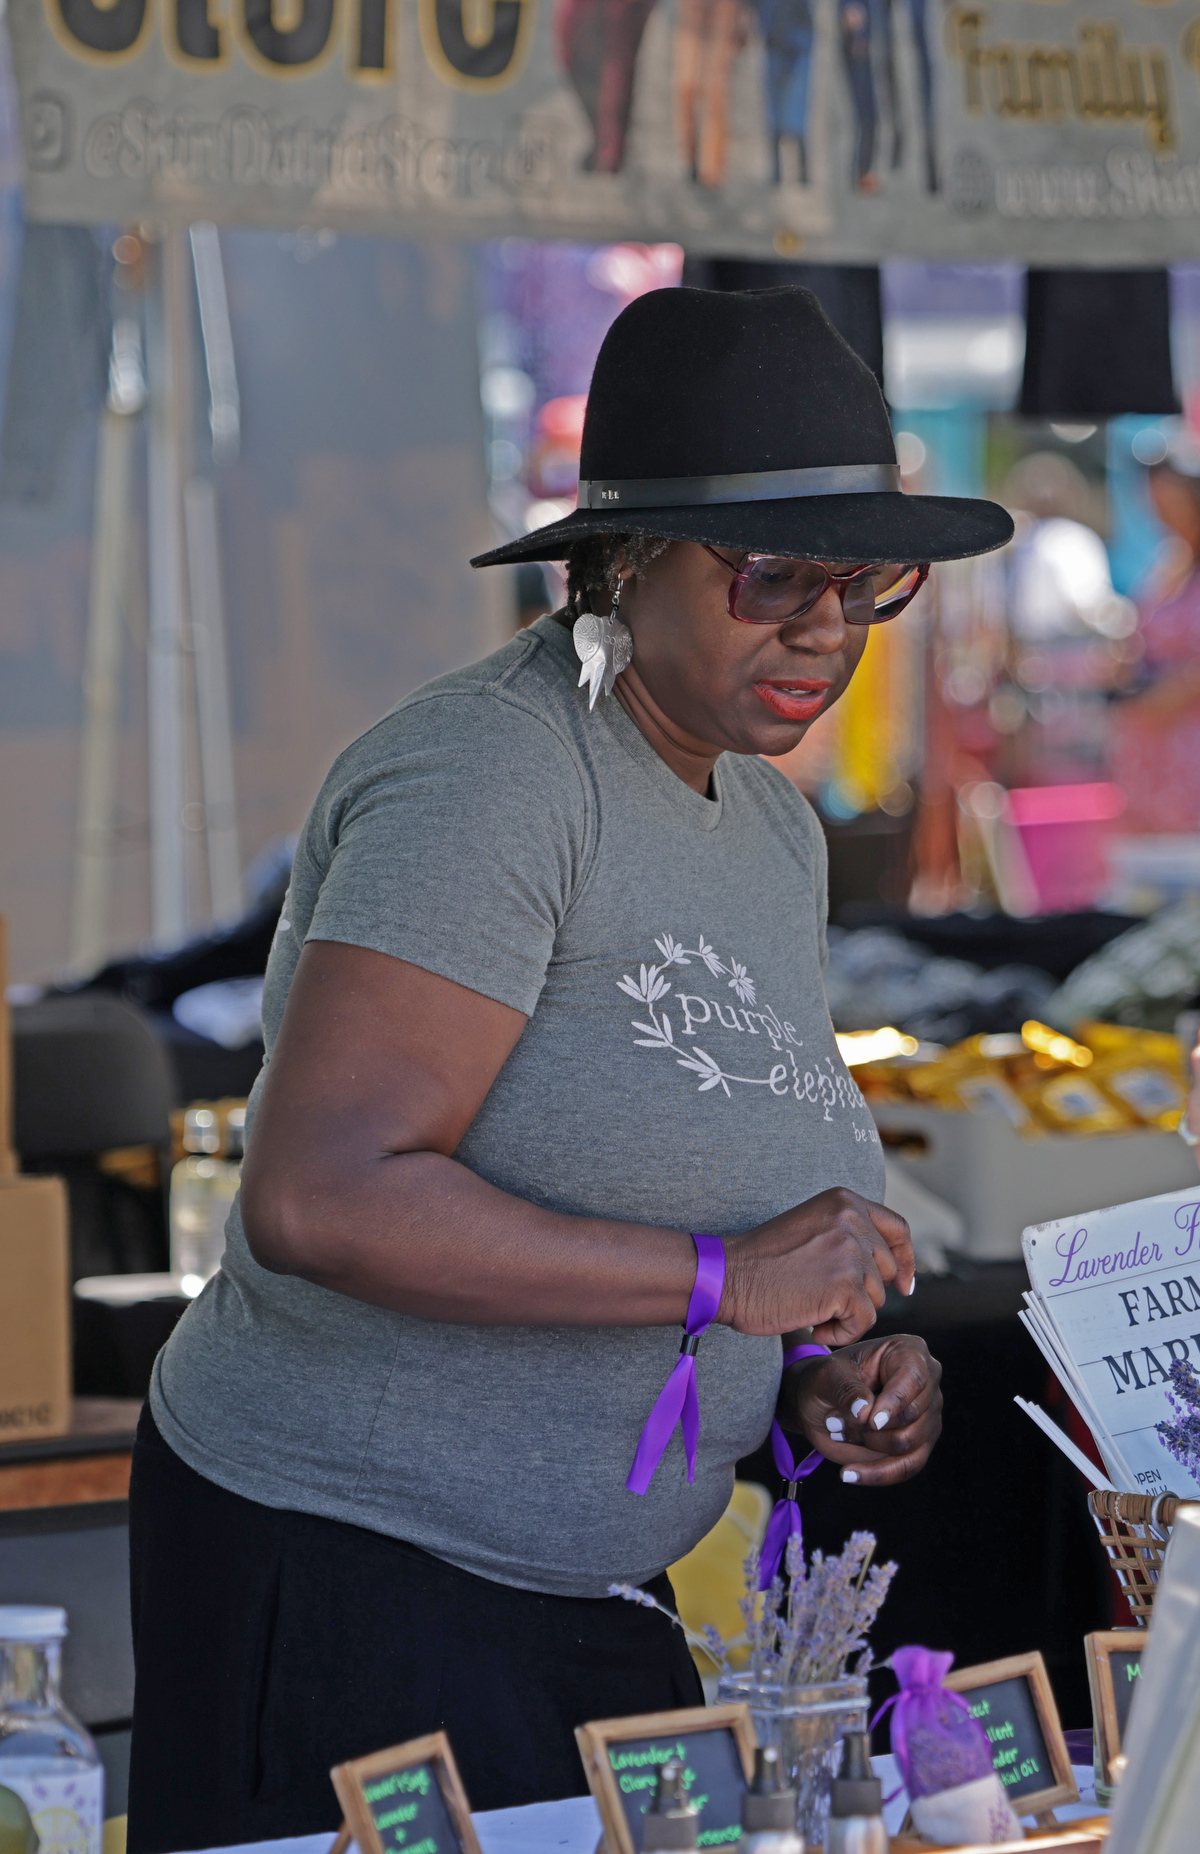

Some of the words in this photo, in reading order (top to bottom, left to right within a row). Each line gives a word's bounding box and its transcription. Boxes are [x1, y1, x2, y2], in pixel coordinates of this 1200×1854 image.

[674, 993, 803, 1051] purple
[1049, 1228, 1163, 1287] Lavender
[609, 1748, 675, 1770] Lavender
[1021, 1758, 1039, 1778] Oil
